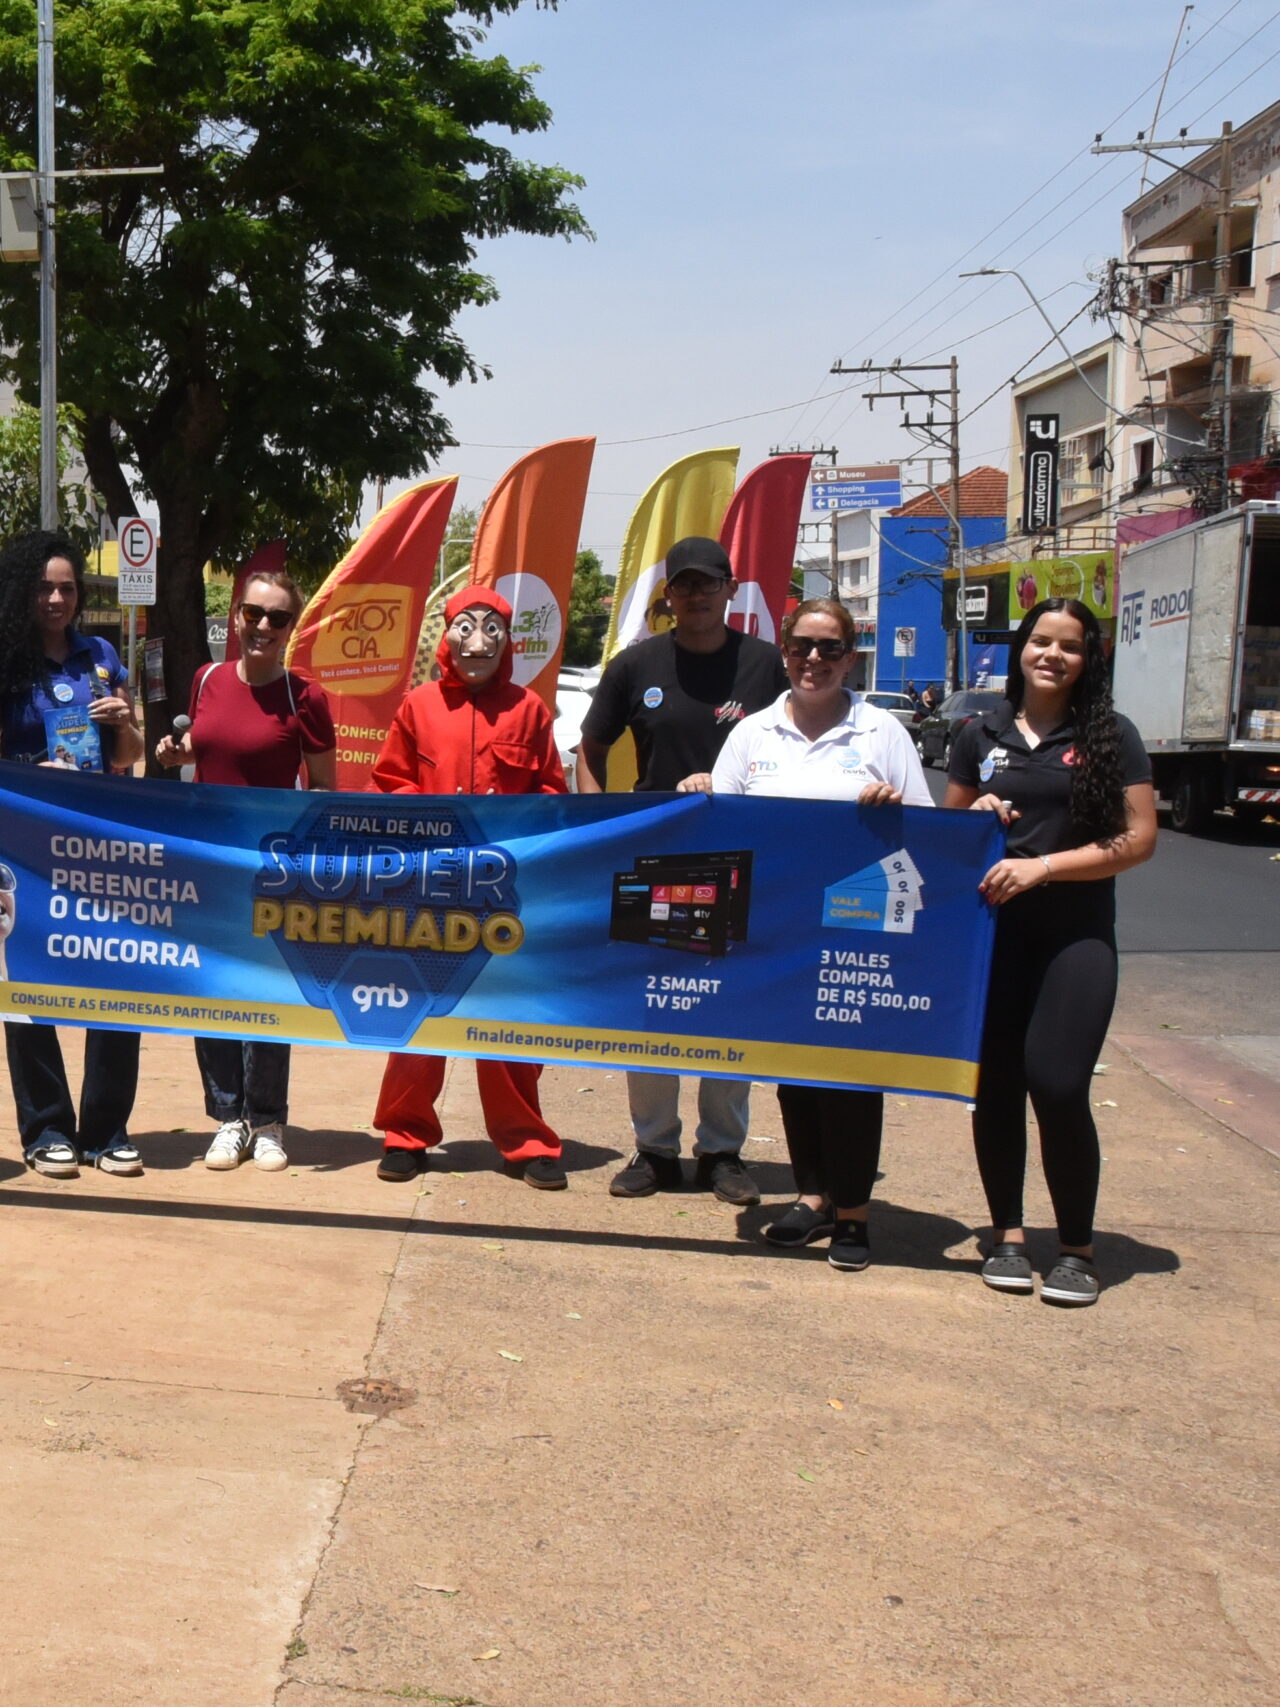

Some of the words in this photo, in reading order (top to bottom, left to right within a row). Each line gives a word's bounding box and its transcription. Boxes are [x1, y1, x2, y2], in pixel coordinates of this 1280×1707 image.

[828, 485, 865, 494] Shopping
[841, 498, 879, 506] Delegacia
[130, 528, 145, 557] E
[122, 571, 153, 584] TÁXIS
[326, 598, 403, 634] FRIOS
[321, 667, 336, 678] Você
[363, 664, 377, 674] Você
[329, 815, 381, 834] FINAL
[386, 819, 408, 835] DE
[413, 820, 452, 837] ANO
[50, 835, 165, 867] COMPRE
[254, 831, 519, 909] SUPER
[51, 868, 200, 904] PREENCHA
[49, 895, 68, 919] O
[75, 897, 173, 928] CUPOM
[830, 896, 861, 906] VALE
[894, 900, 905, 924] 500
[829, 908, 880, 919] COMPRA
[252, 898, 525, 955] PREMIADO
[47, 933, 201, 968] CONCORRA
[821, 950, 830, 964] 3
[834, 951, 890, 969] VALES
[646, 975, 657, 989] 2
[660, 976, 722, 994] SMART
[819, 969, 894, 988] COMPRA
[11, 992, 76, 1008] CONSULTE
[78, 998, 96, 1010] AS
[99, 1000, 170, 1017] EMPRESAS
[173, 1006, 280, 1025] PARTICIPANTES:
[352, 983, 409, 1013] gmb
[645, 993, 668, 1008] TV
[817, 987, 839, 1003] DE
[843, 989, 867, 1007] R$
[870, 992, 931, 1011] 500,00
[815, 1006, 862, 1024] CADA
[466, 1027, 745, 1063] finaldeanosuperpremiado.com.br
